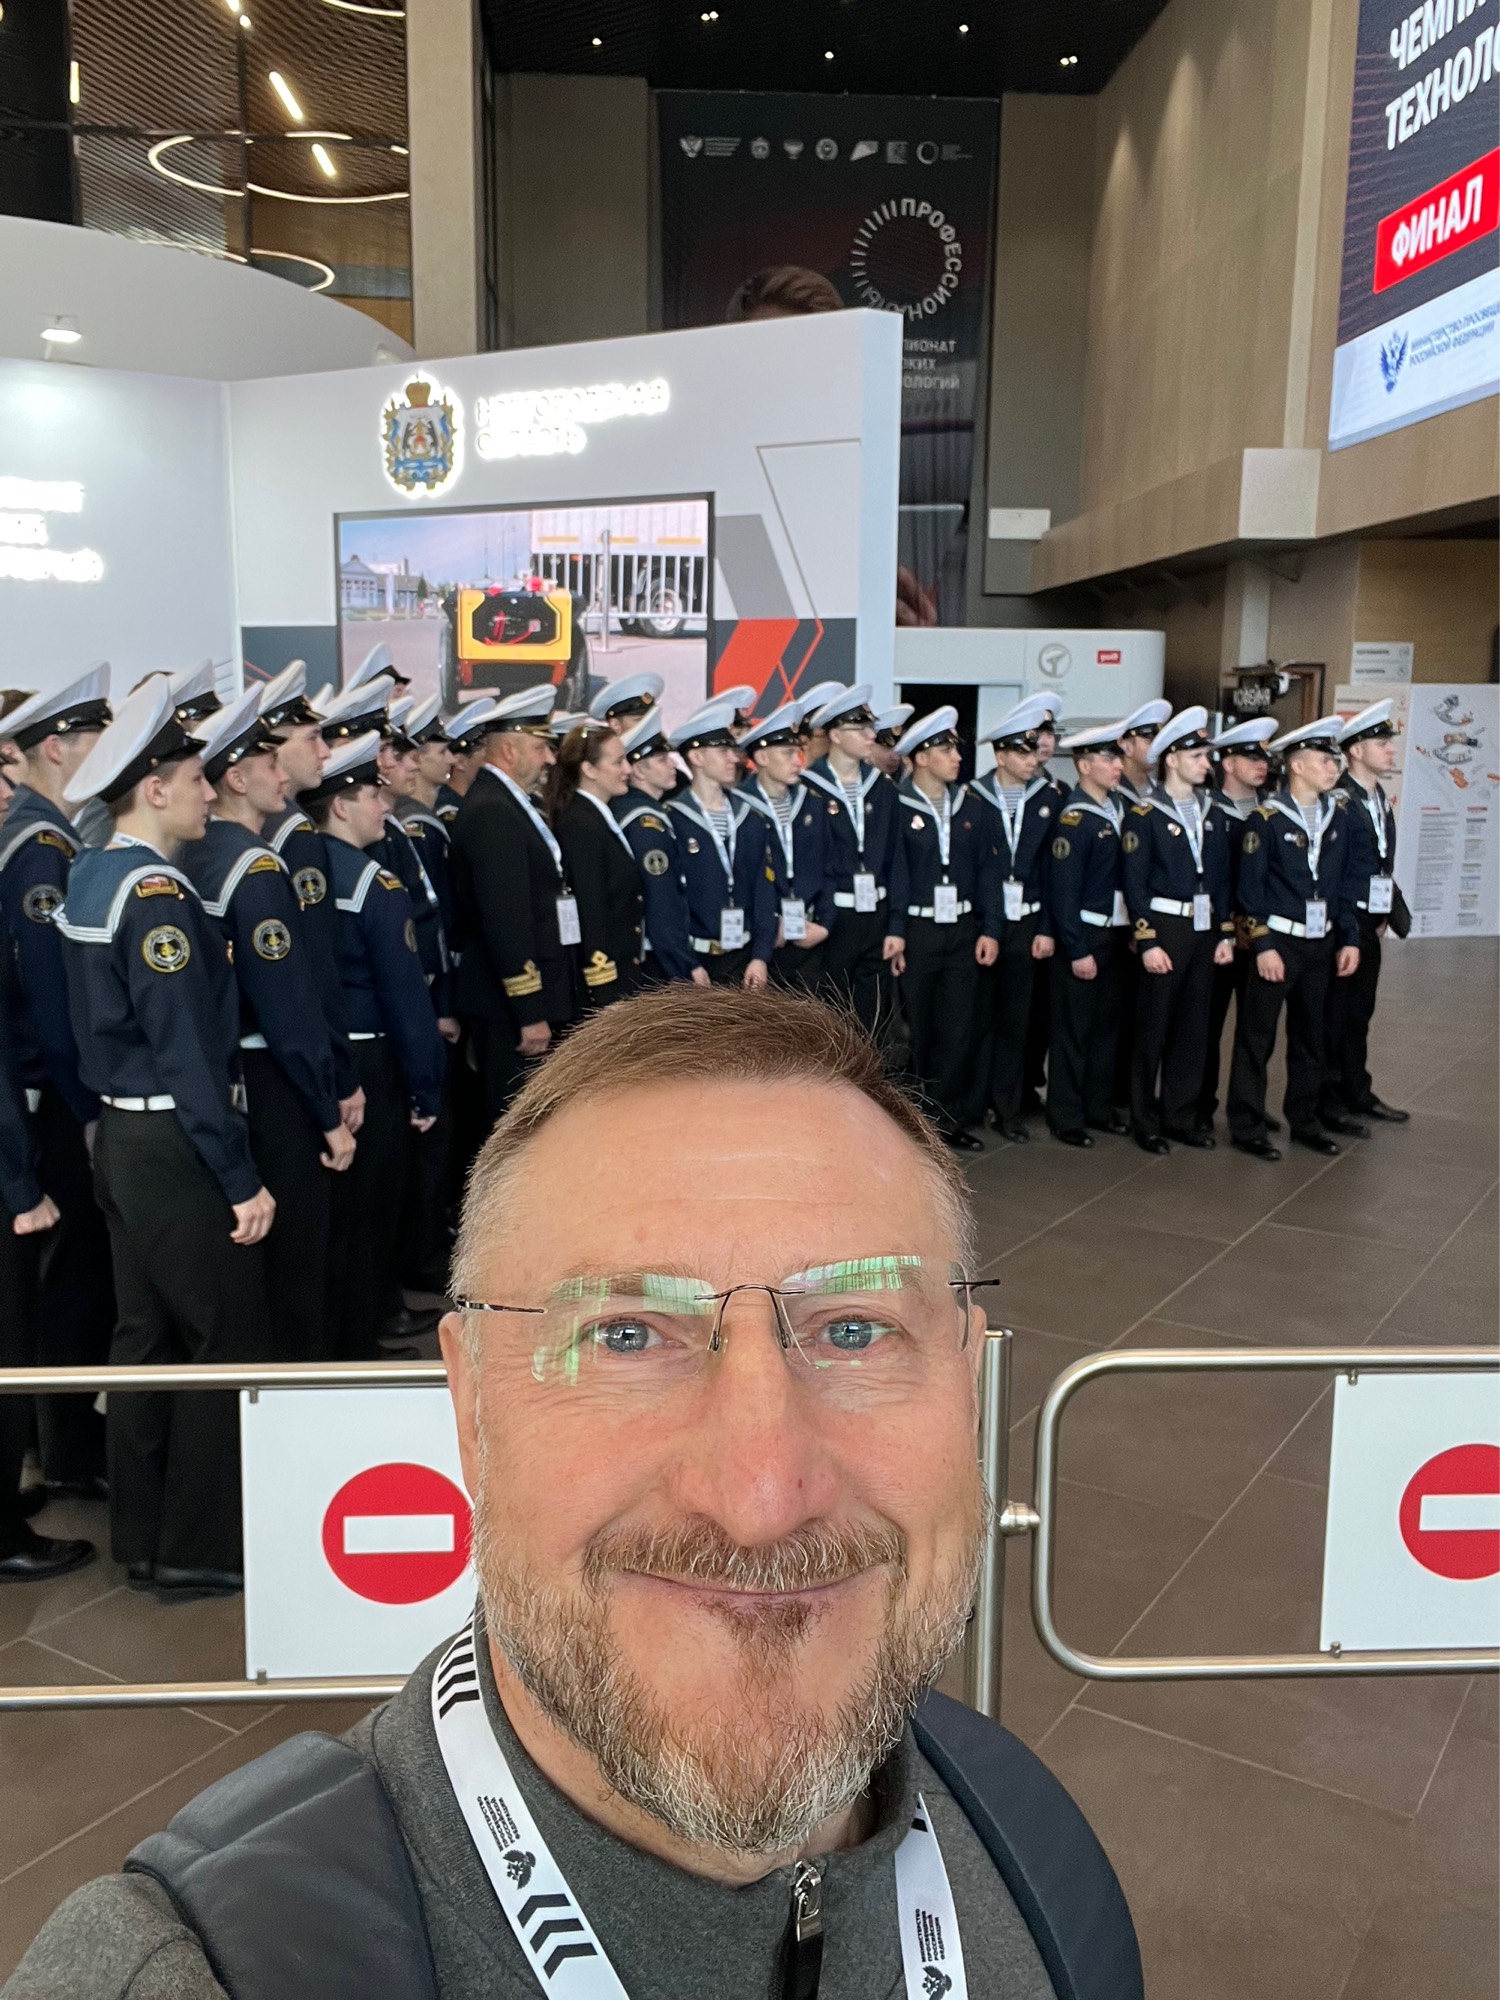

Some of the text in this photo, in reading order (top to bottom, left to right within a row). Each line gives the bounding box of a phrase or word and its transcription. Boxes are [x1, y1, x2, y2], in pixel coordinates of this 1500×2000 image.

[1389, 0, 1487, 71] ЧЕМ
[1391, 173, 1484, 267] ФИНАЛ
[903, 339, 957, 354] ИОНАТ
[903, 374, 960, 390] ОЛОГИЙ
